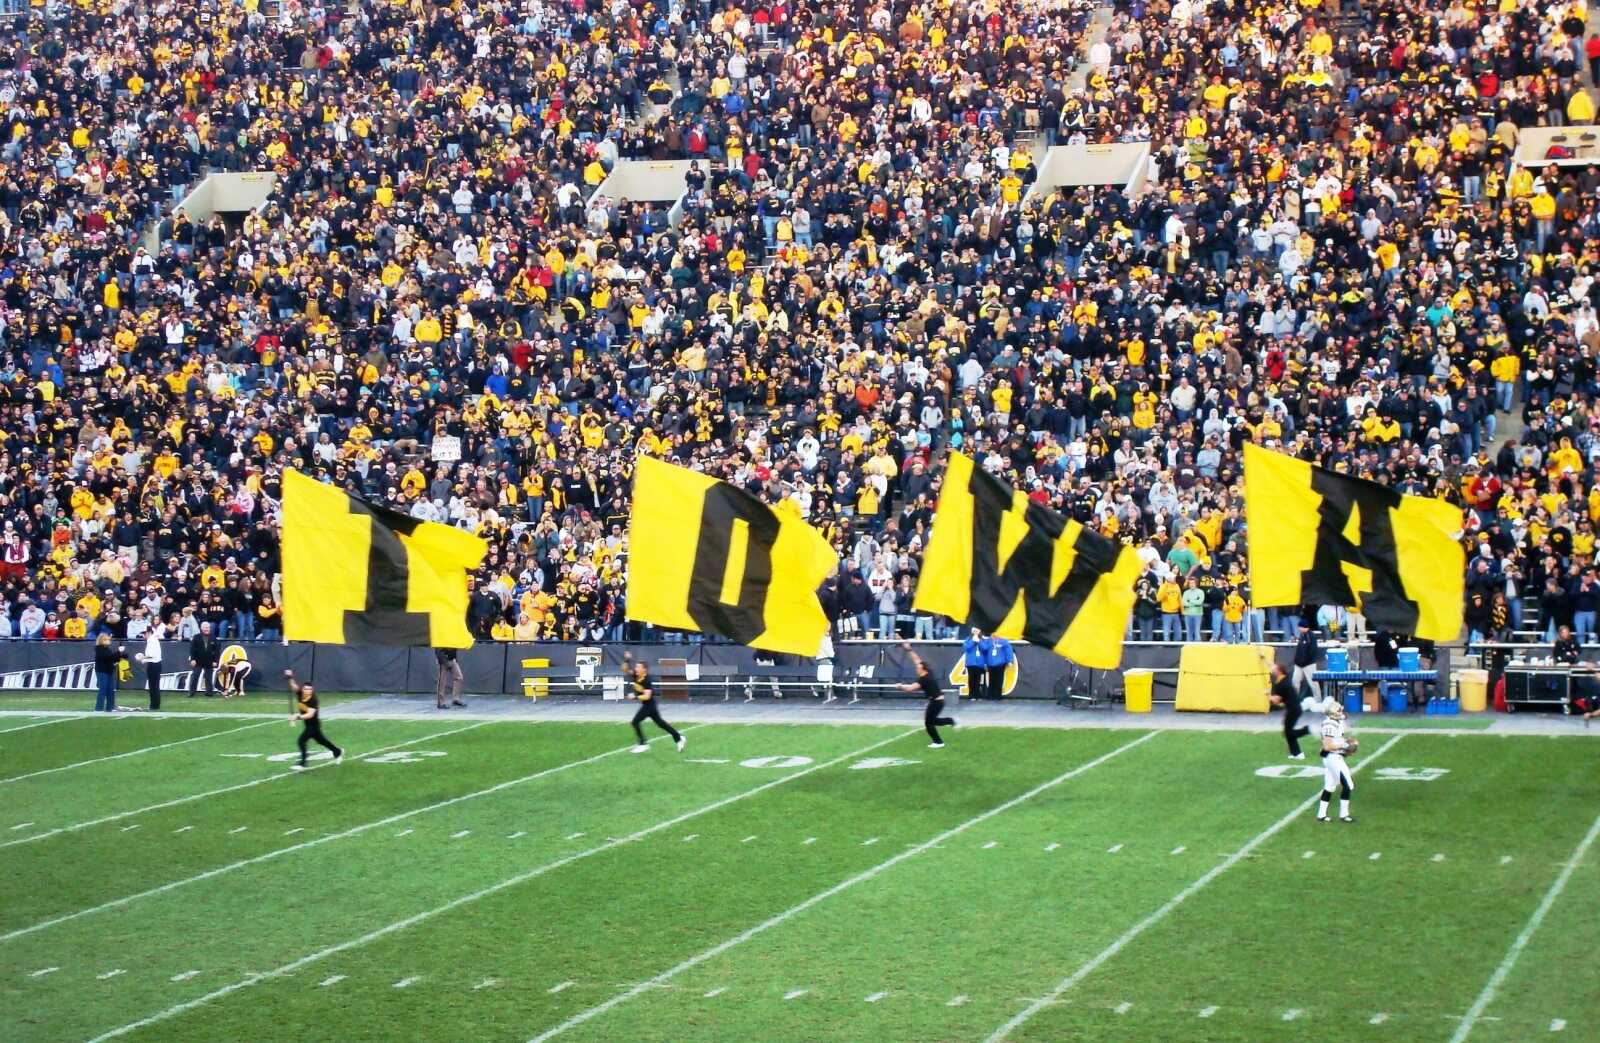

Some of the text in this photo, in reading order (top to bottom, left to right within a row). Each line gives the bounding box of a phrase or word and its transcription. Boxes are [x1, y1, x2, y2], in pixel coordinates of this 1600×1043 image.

[343, 463, 1420, 649] I O W A
